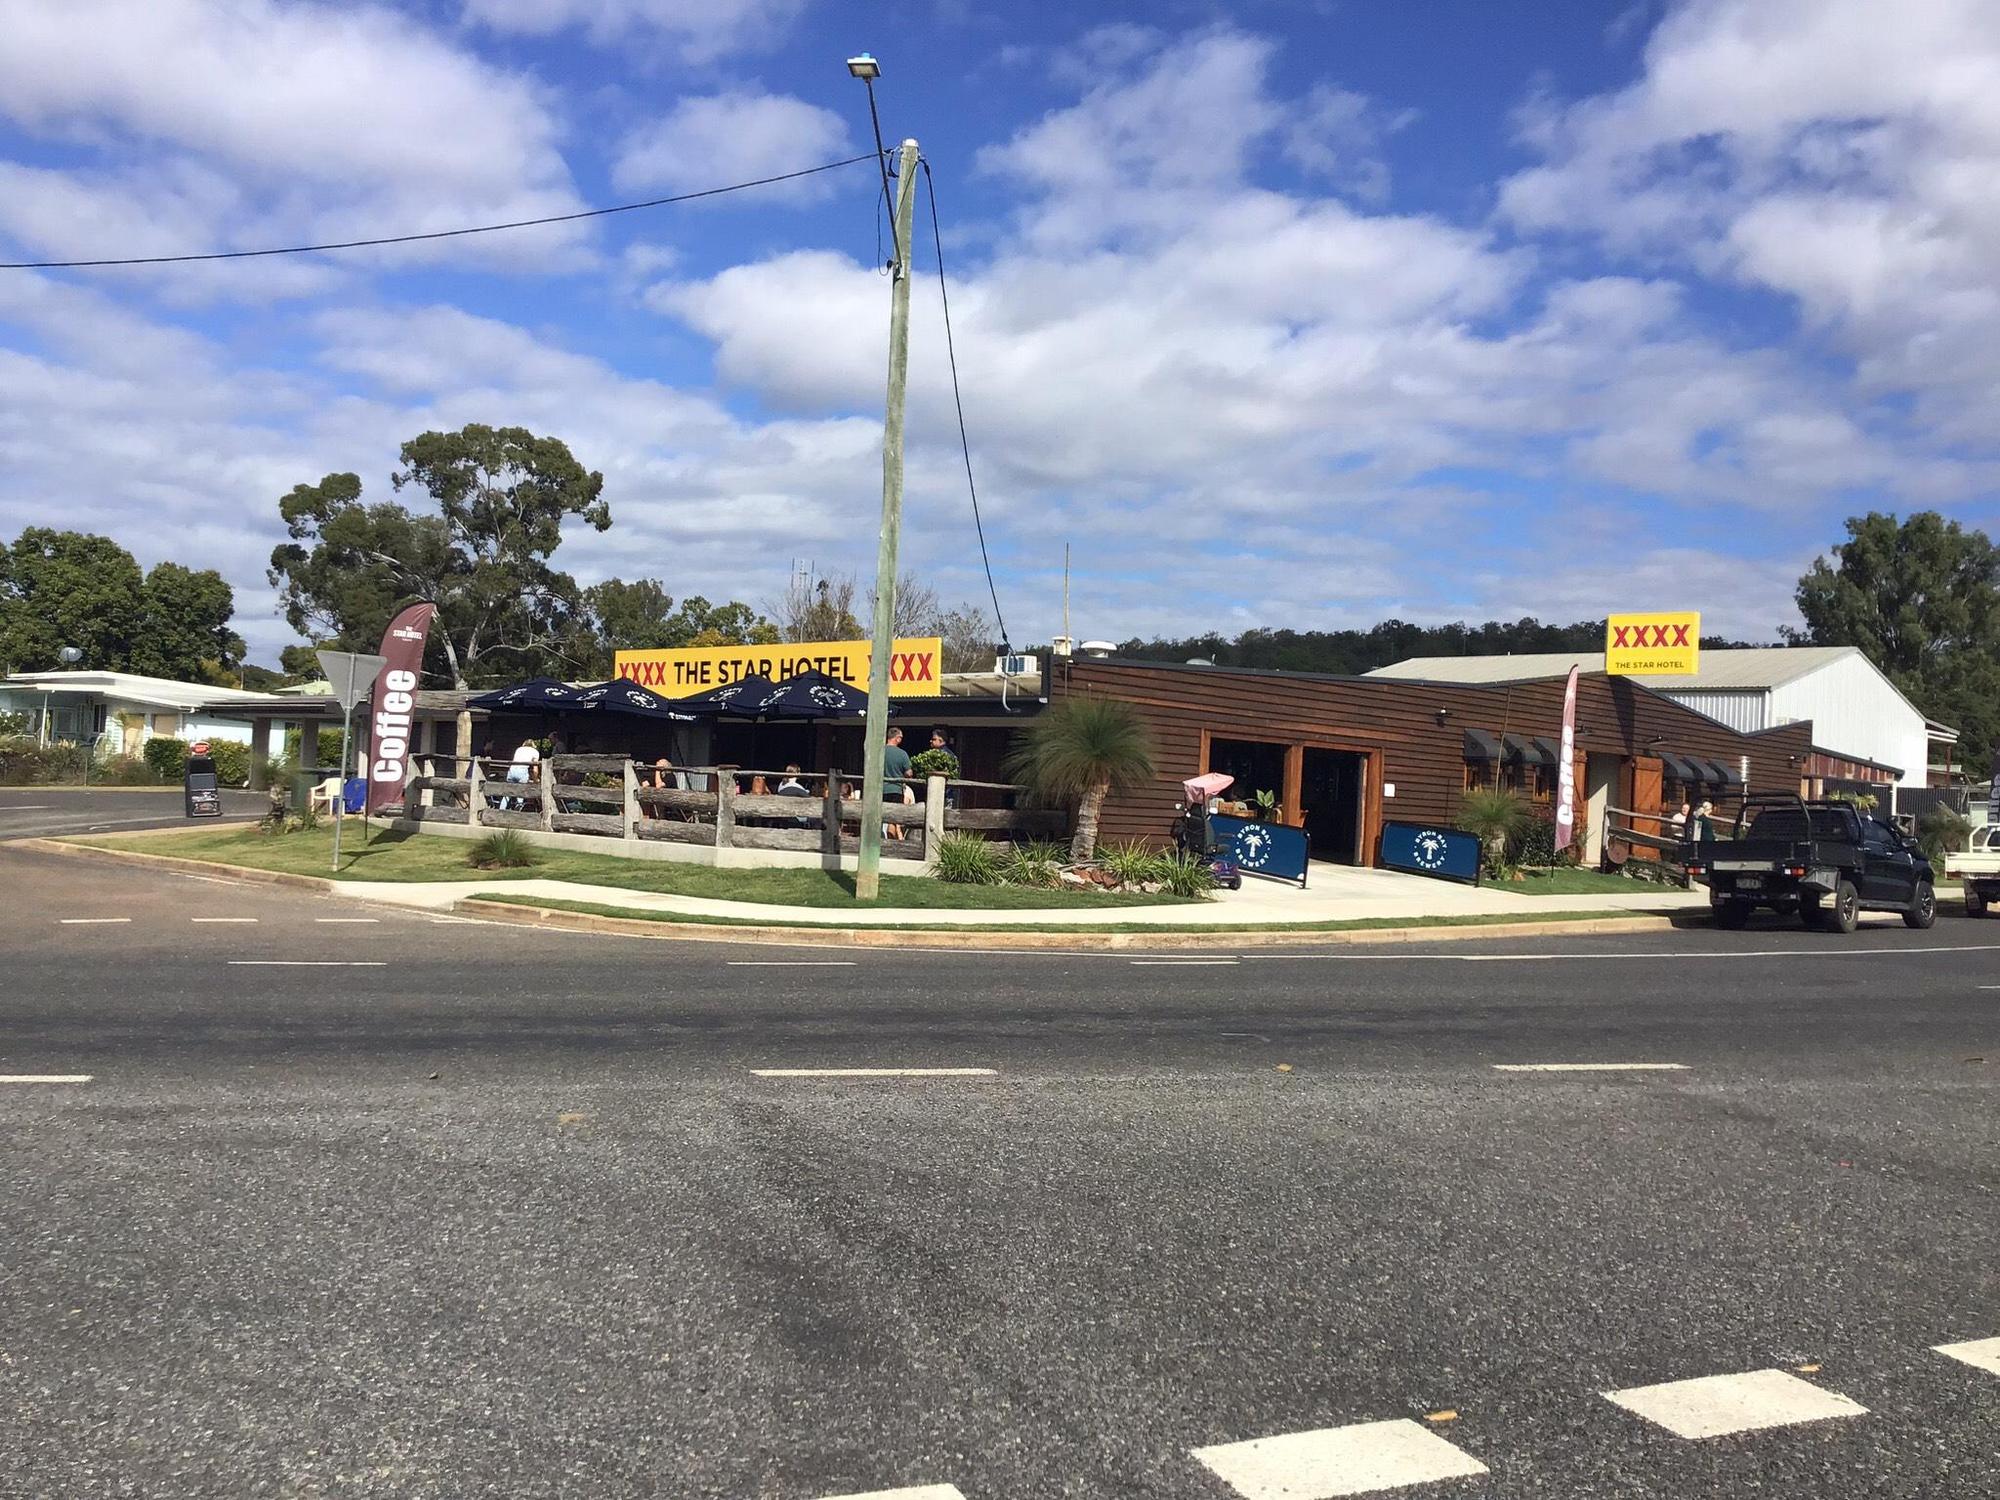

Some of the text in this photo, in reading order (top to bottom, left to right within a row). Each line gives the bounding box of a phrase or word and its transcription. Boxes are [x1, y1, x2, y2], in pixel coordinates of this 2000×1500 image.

[1613, 624, 1690, 648] XXXX
[619, 653, 933, 686] XXXX THE STAR HOTEL XXX
[1633, 661, 1655, 669] STAR
[373, 670, 416, 782] Coffee
[1237, 824, 1272, 845] BYRON BAY
[1415, 830, 1448, 848] BYRON BAY
[1235, 848, 1269, 868] BREWERY
[1413, 852, 1446, 869] BREWERY
